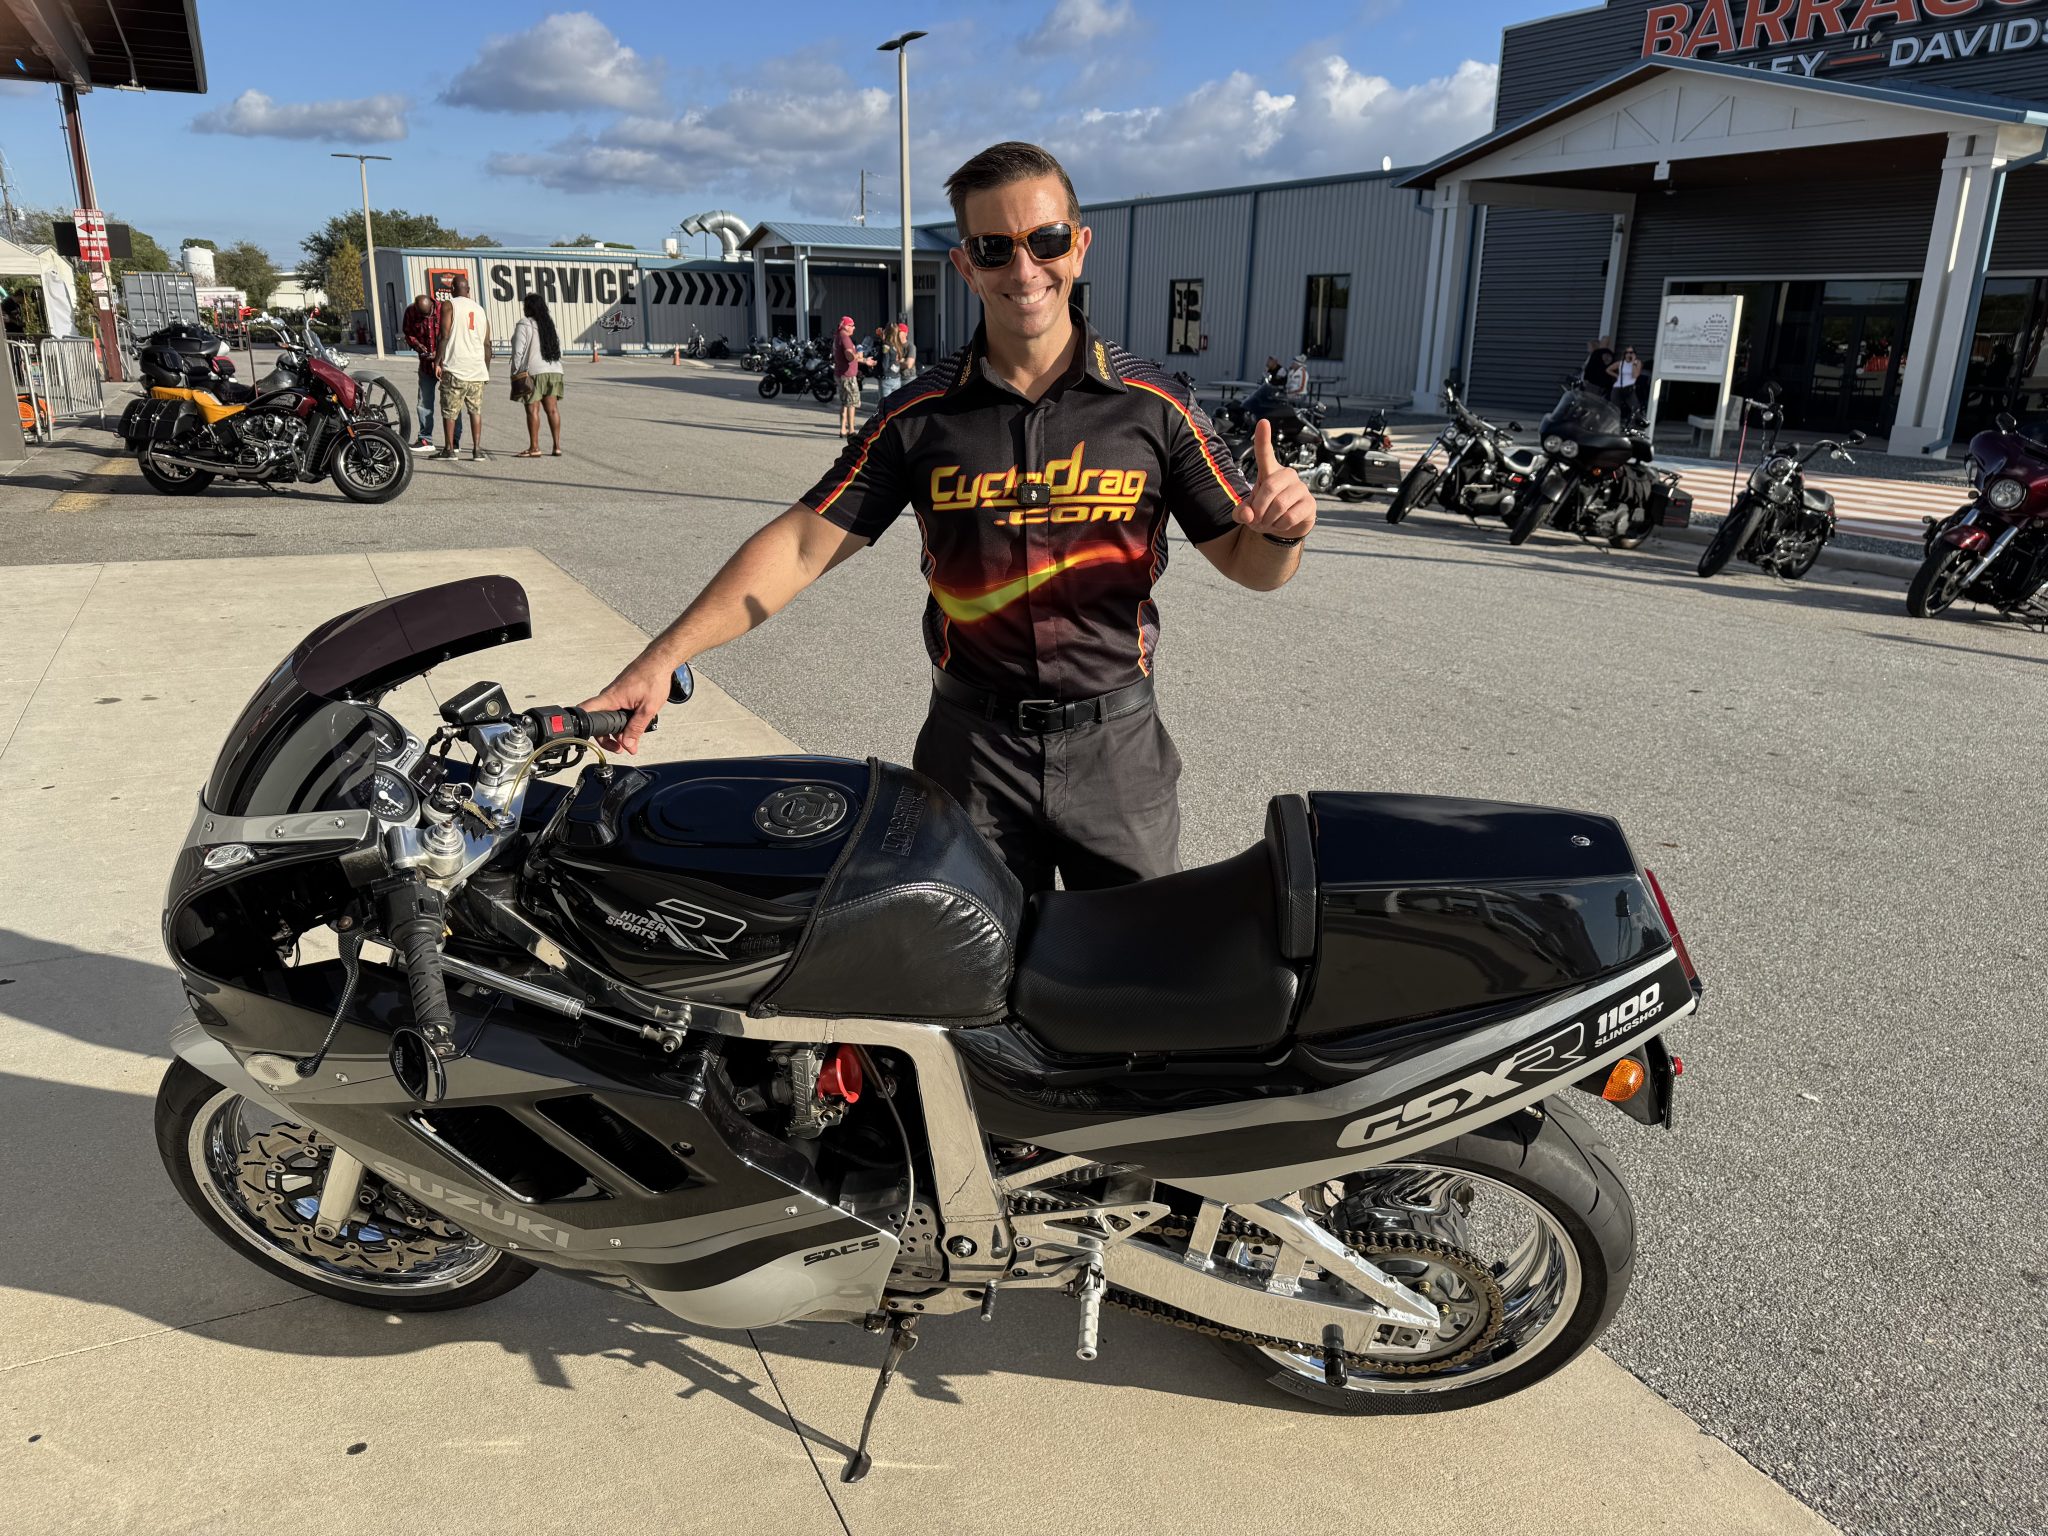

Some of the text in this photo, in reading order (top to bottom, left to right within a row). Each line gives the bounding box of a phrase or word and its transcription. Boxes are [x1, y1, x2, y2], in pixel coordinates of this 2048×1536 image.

[1888, 17, 2048, 67] DAVID
[490, 264, 637, 305] SERVICE
[468, 311, 475, 331] 1
[605, 915, 659, 941] SPORTS
[619, 910, 668, 934] HYPER
[1594, 1001, 1665, 1049] SLINGSHOT
[1597, 982, 1661, 1037] 1100
[373, 1161, 570, 1249] SUZUKI
[803, 1237, 881, 1267] SACS
